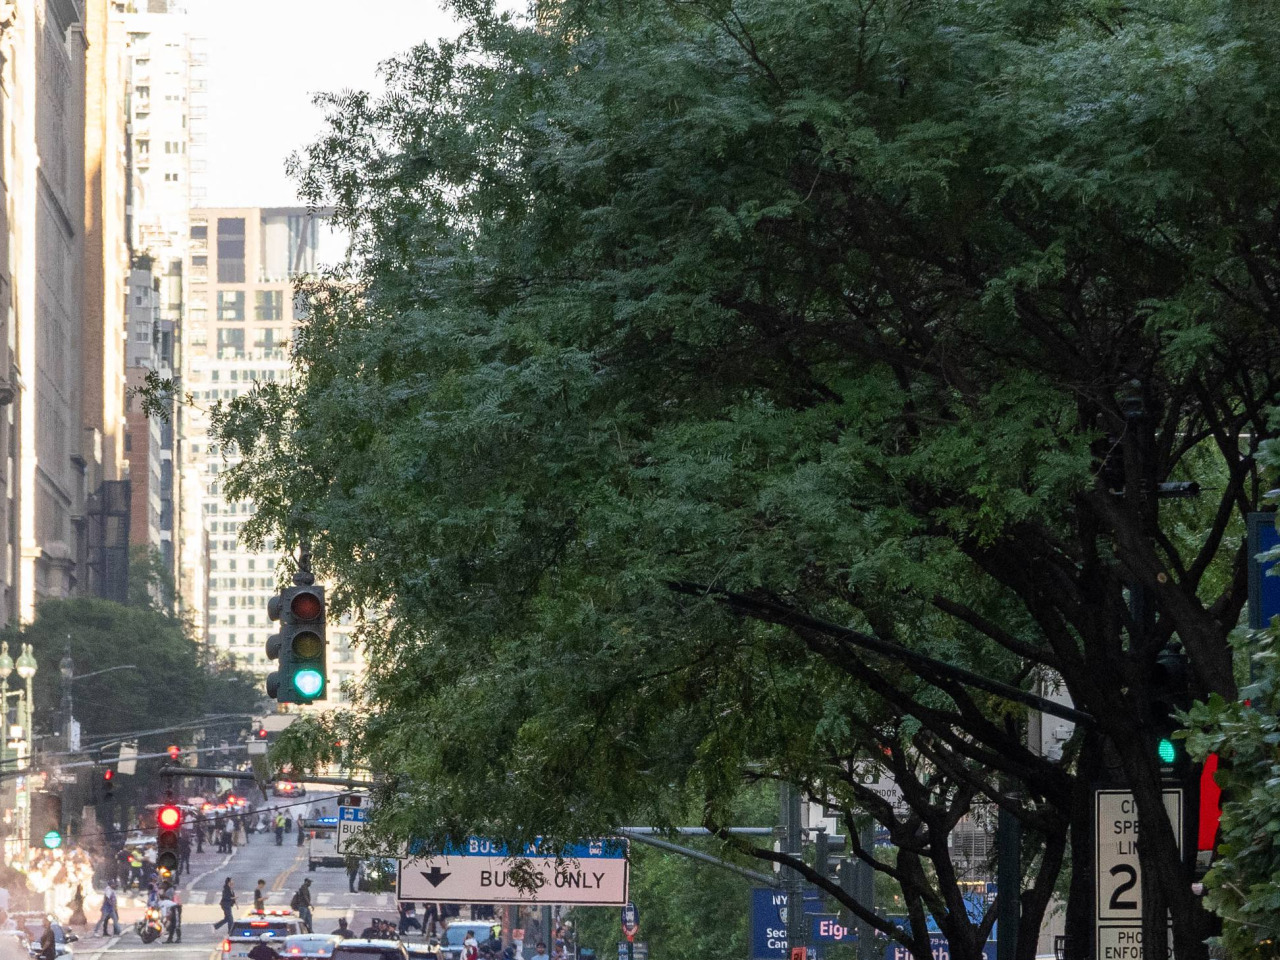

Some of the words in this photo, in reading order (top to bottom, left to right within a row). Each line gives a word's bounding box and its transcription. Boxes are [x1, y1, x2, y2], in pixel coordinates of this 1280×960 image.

[480, 870, 545, 889] BUS
[554, 871, 605, 889] ONLY
[1109, 864, 1138, 909] 2
